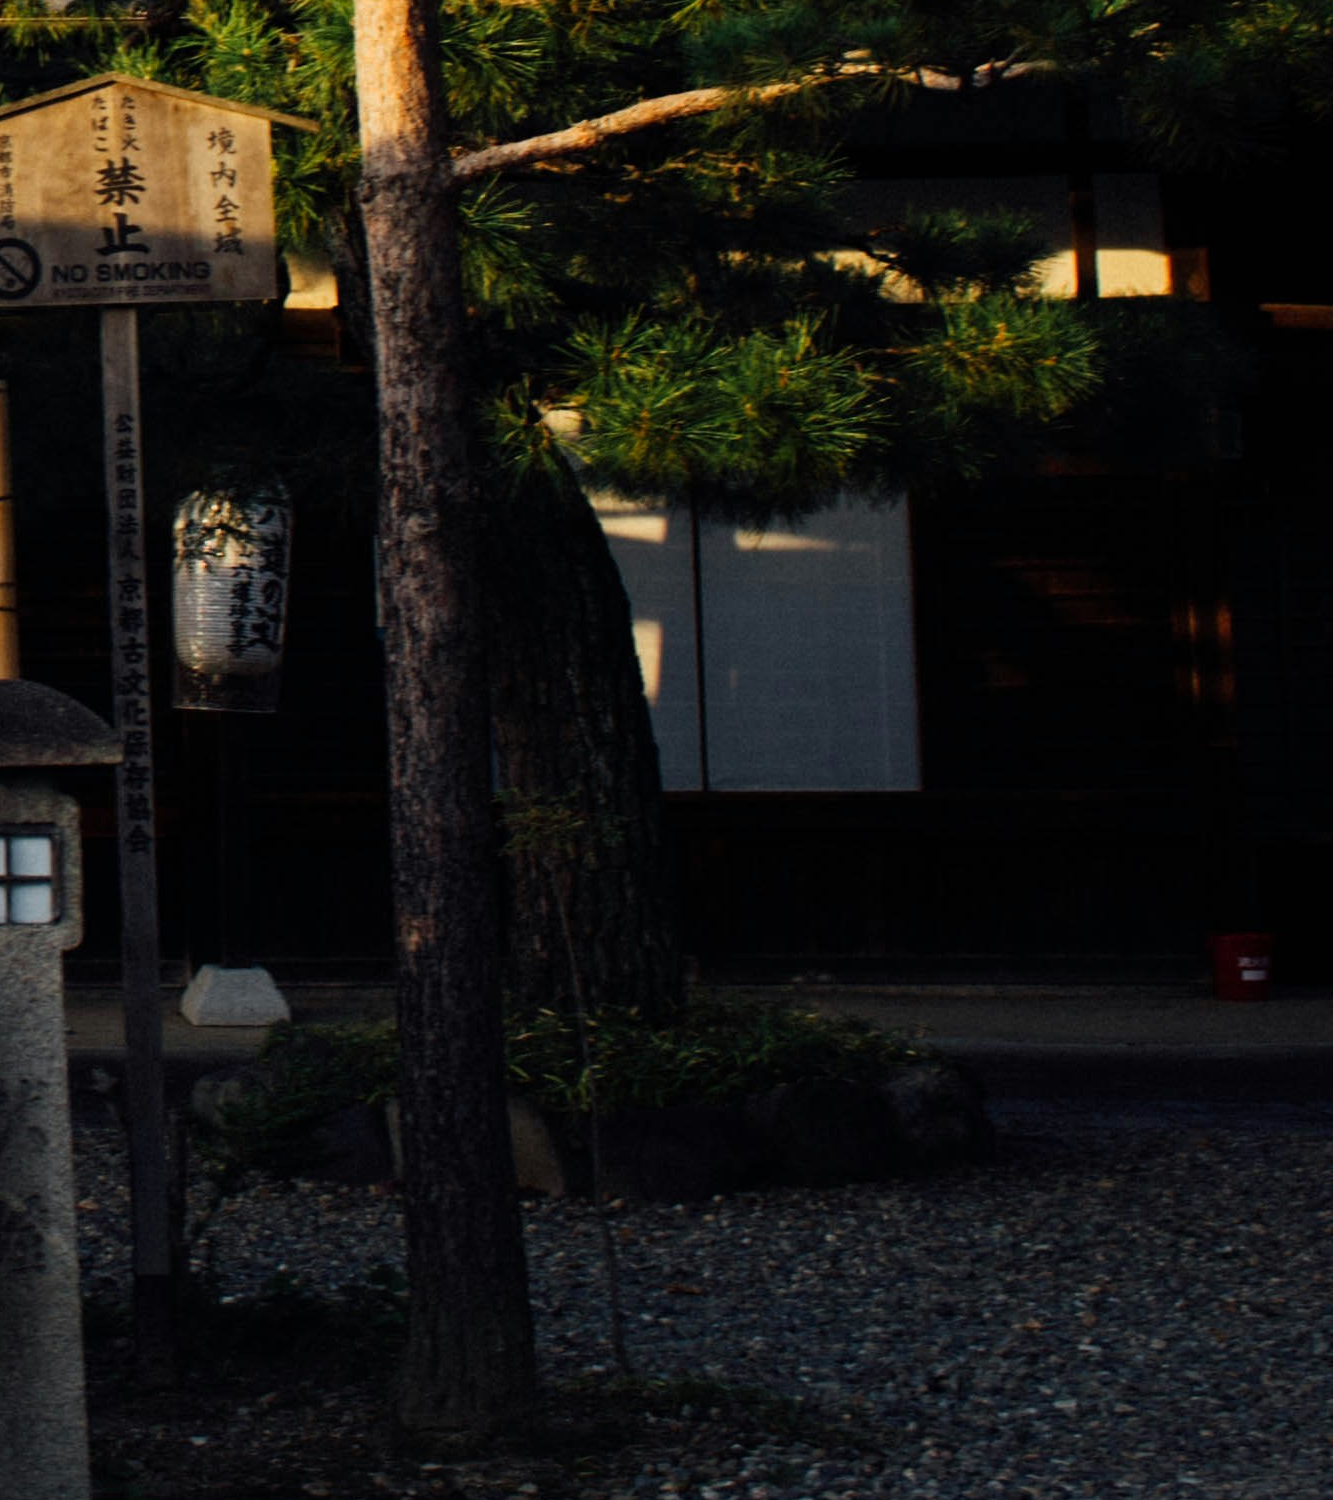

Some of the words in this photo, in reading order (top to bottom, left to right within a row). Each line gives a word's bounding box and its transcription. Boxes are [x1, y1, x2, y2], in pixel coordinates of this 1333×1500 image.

[90, 96, 109, 153] たばこ
[120, 96, 142, 153] たき火
[95, 156, 150, 258] 禁止
[208, 126, 245, 257] 境内全域
[52, 264, 87, 283] NO
[97, 261, 212, 282] SMOKING
[114, 412, 139, 561] 公益財団法人
[116, 573, 153, 857] 京都古文化保存協会
